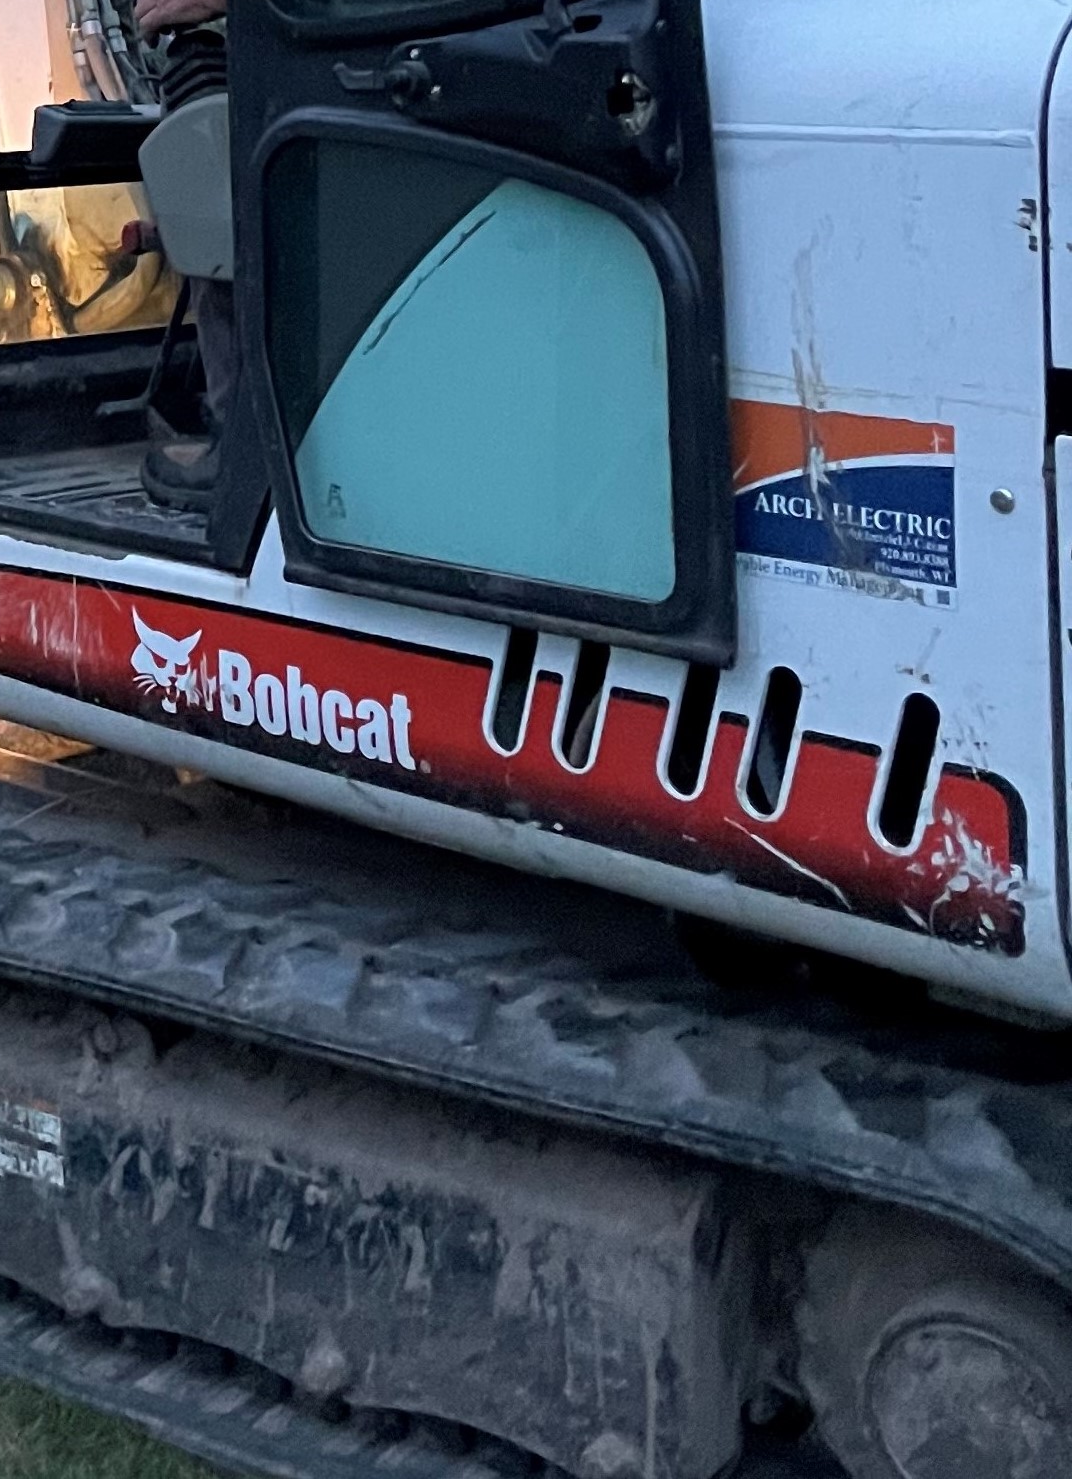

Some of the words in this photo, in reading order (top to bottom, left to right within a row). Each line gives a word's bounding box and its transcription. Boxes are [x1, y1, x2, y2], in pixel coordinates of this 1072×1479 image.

[754, 491, 824, 521] ARCH
[832, 502, 951, 540] ELECTRIC
[217, 648, 418, 771] Bobcat
